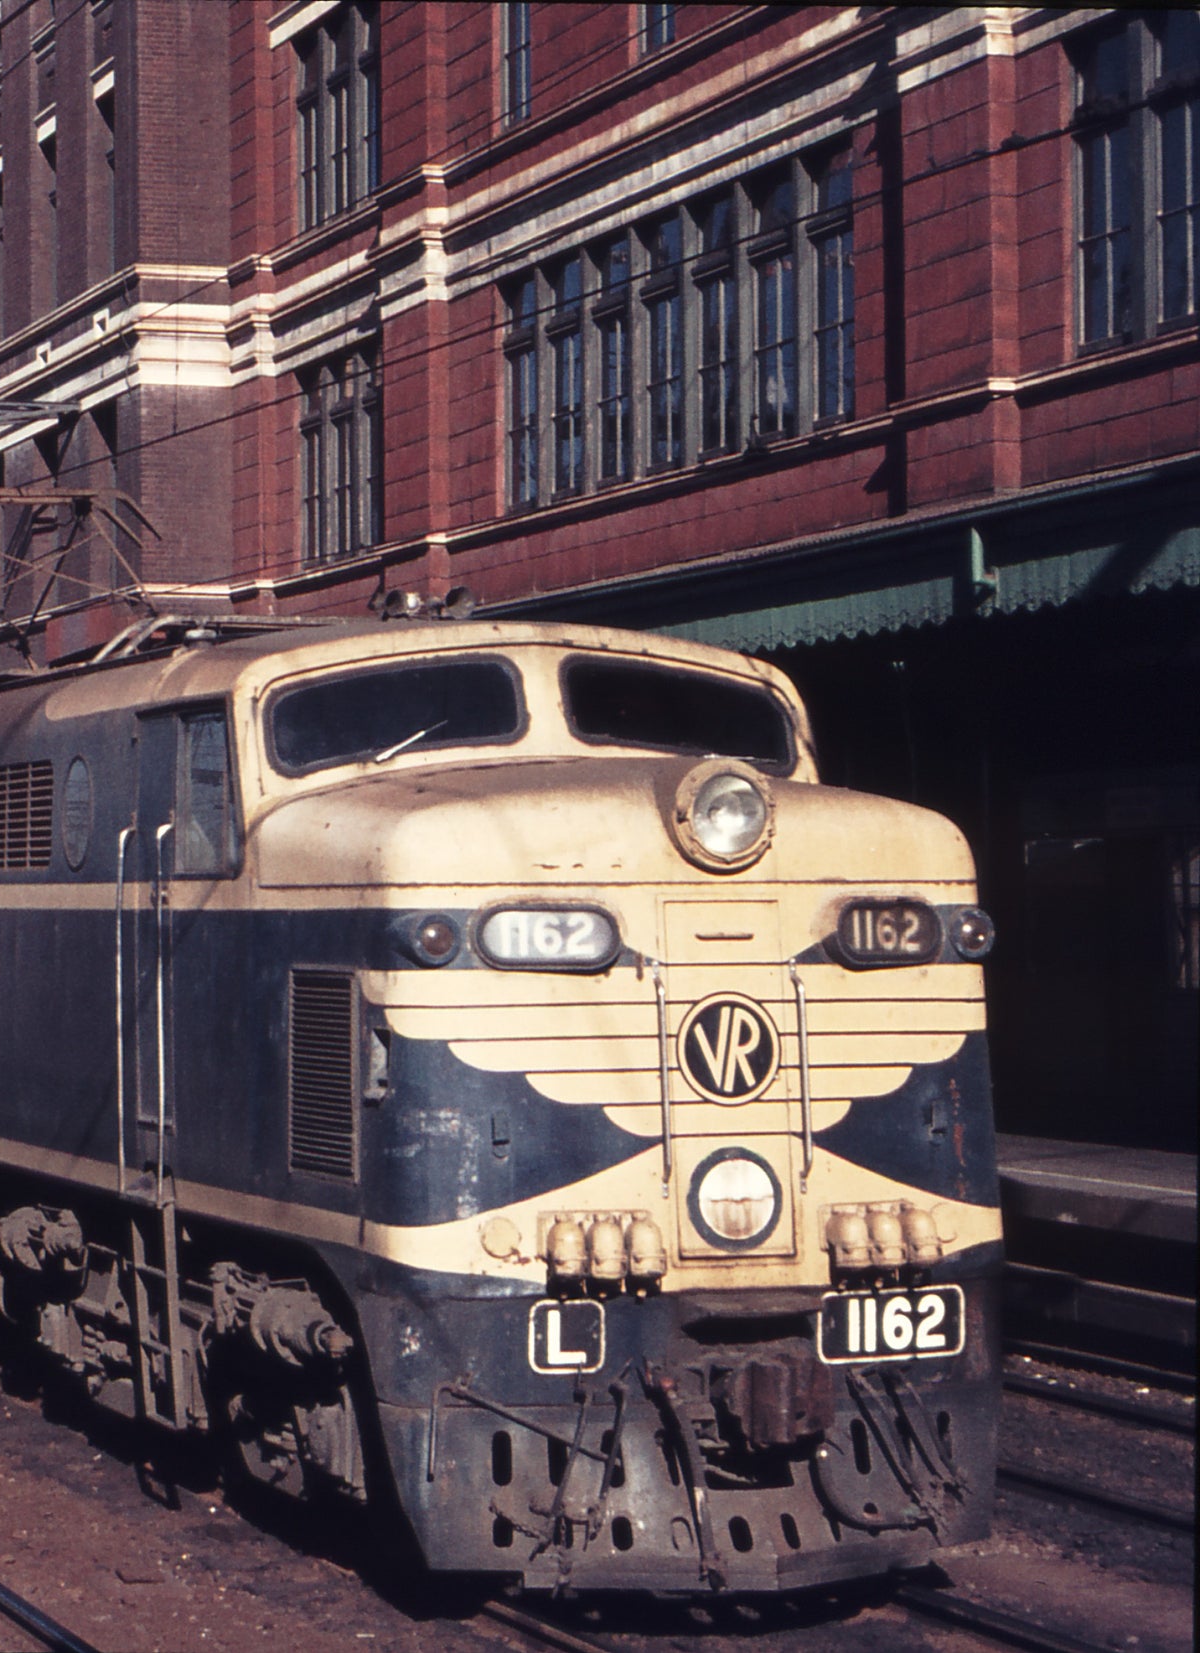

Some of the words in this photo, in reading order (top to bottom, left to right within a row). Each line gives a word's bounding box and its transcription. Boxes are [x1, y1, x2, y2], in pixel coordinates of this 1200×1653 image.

[500, 911, 595, 957] 1162
[852, 909, 920, 952] 1162
[693, 1006, 760, 1093] VR
[547, 1309, 587, 1365] L
[848, 1294, 946, 1352] 1162
